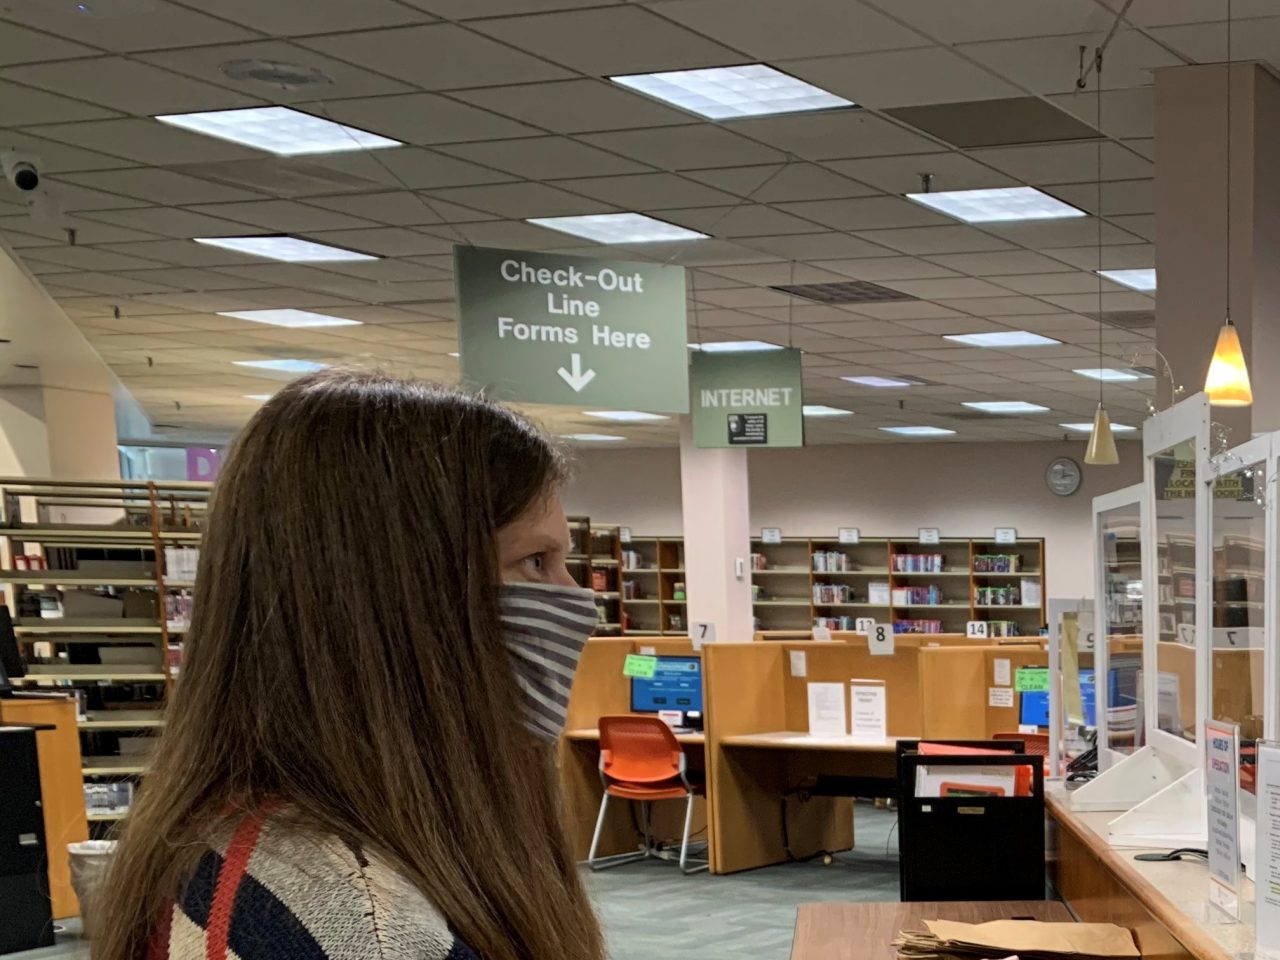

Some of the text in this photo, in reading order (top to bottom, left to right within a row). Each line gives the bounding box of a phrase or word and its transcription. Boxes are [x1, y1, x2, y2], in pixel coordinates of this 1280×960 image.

[500, 259, 644, 294] Check-Out
[547, 293, 601, 318] Line
[497, 317, 651, 350] Forms Here
[701, 387, 792, 408] INTERNET
[1168, 479, 1195, 488] LOCA
[699, 624, 708, 638] 7
[876, 626, 886, 642] 8
[970, 623, 985, 635] 14
